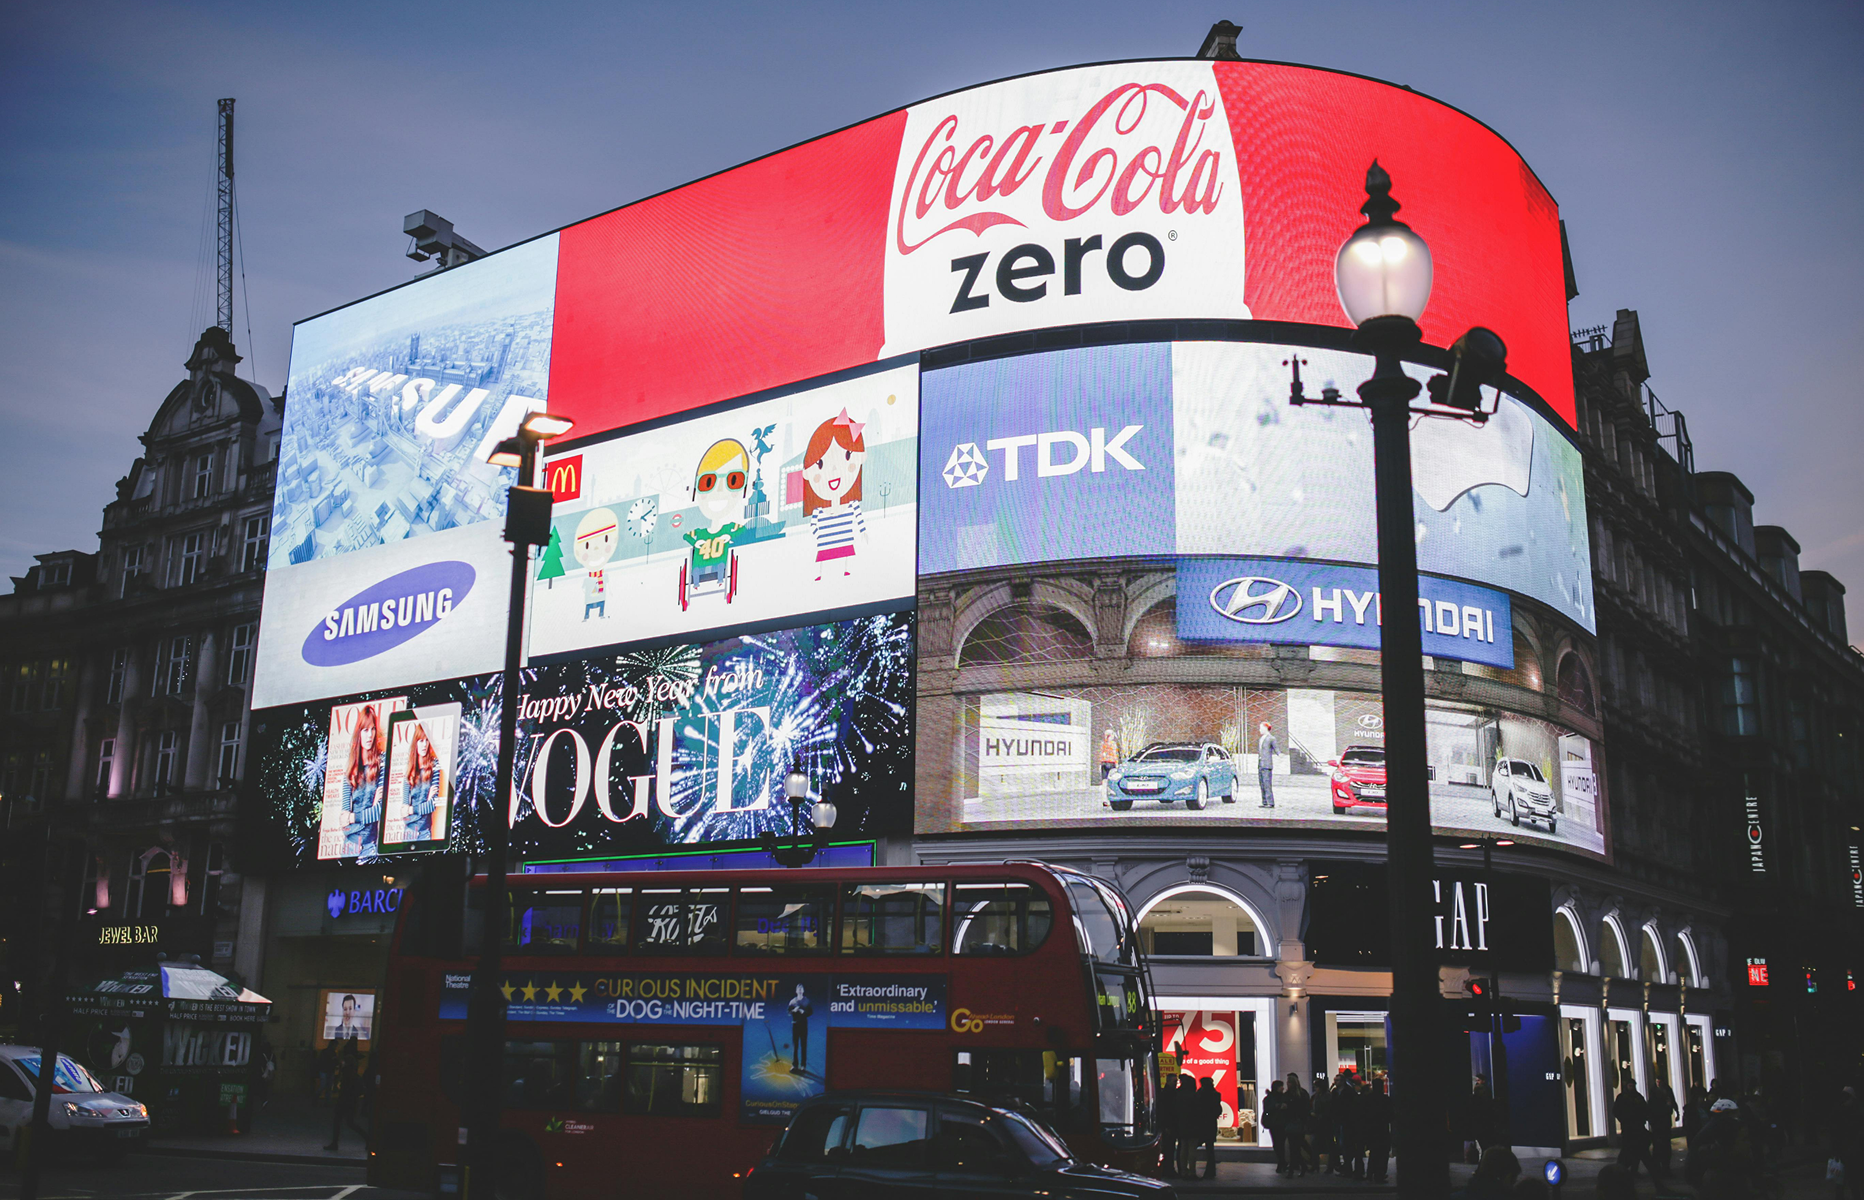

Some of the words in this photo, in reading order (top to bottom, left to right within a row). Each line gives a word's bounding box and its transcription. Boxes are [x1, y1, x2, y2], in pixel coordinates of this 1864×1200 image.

[897, 83, 1224, 255] Coca-Cola
[949, 232, 1165, 314] zero
[987, 425, 1146, 481] TDK
[699, 537, 725, 560] 40
[324, 588, 452, 641] SAMSUNG
[1313, 586, 1494, 643] HYNDAI
[585, 683, 638, 712] New
[646, 675, 699, 703] Year
[700, 664, 763, 701] from
[985, 737, 1072, 756] HYUNDAI
[1567, 774, 1593, 795] HYUNDAI
[1750, 844, 1766, 872] JAPAN
[98, 926, 132, 944] JEWEL
[134, 925, 158, 943] BAR
[94, 980, 154, 994] WICKED
[445, 974, 471, 982] National
[594, 978, 681, 998] CURIOUS
[685, 977, 780, 999] INCIDENT
[616, 999, 662, 1019] DOG
[673, 1000, 765, 1020] NIGHT-TIME
[830, 1000, 855, 1012] and
[951, 1008, 984, 1033] Go
[1165, 1010, 1235, 1053] 75
[160, 1022, 252, 1067] WICKED
[1214, 1058, 1229, 1066] thing
